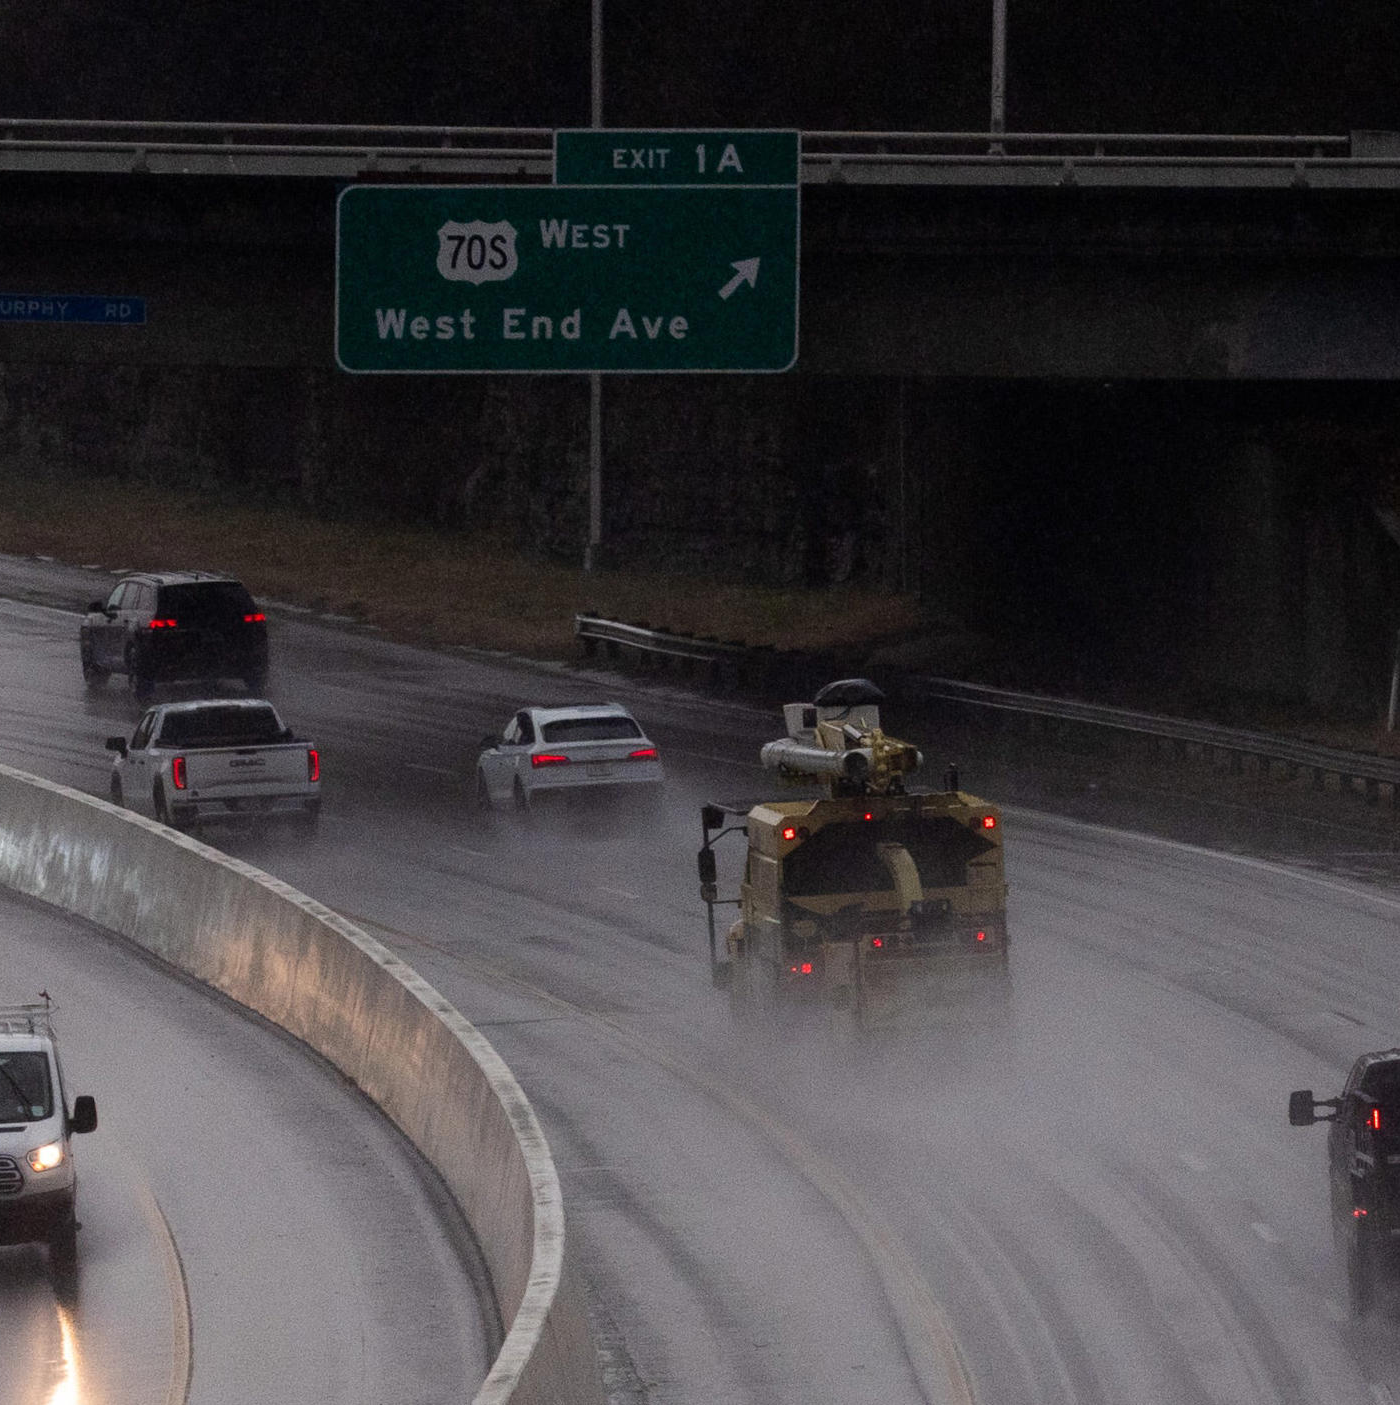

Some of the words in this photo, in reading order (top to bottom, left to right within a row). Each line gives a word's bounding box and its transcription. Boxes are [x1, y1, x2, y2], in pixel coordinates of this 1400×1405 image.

[612, 148, 670, 169] EXIT
[695, 143, 743, 173] 1A
[446, 234, 509, 271] 70S
[105, 303, 132, 318] RD
[375, 308, 476, 340] West
[502, 308, 582, 340] End
[608, 308, 690, 340] Ave
[230, 759, 266, 768] GMC
